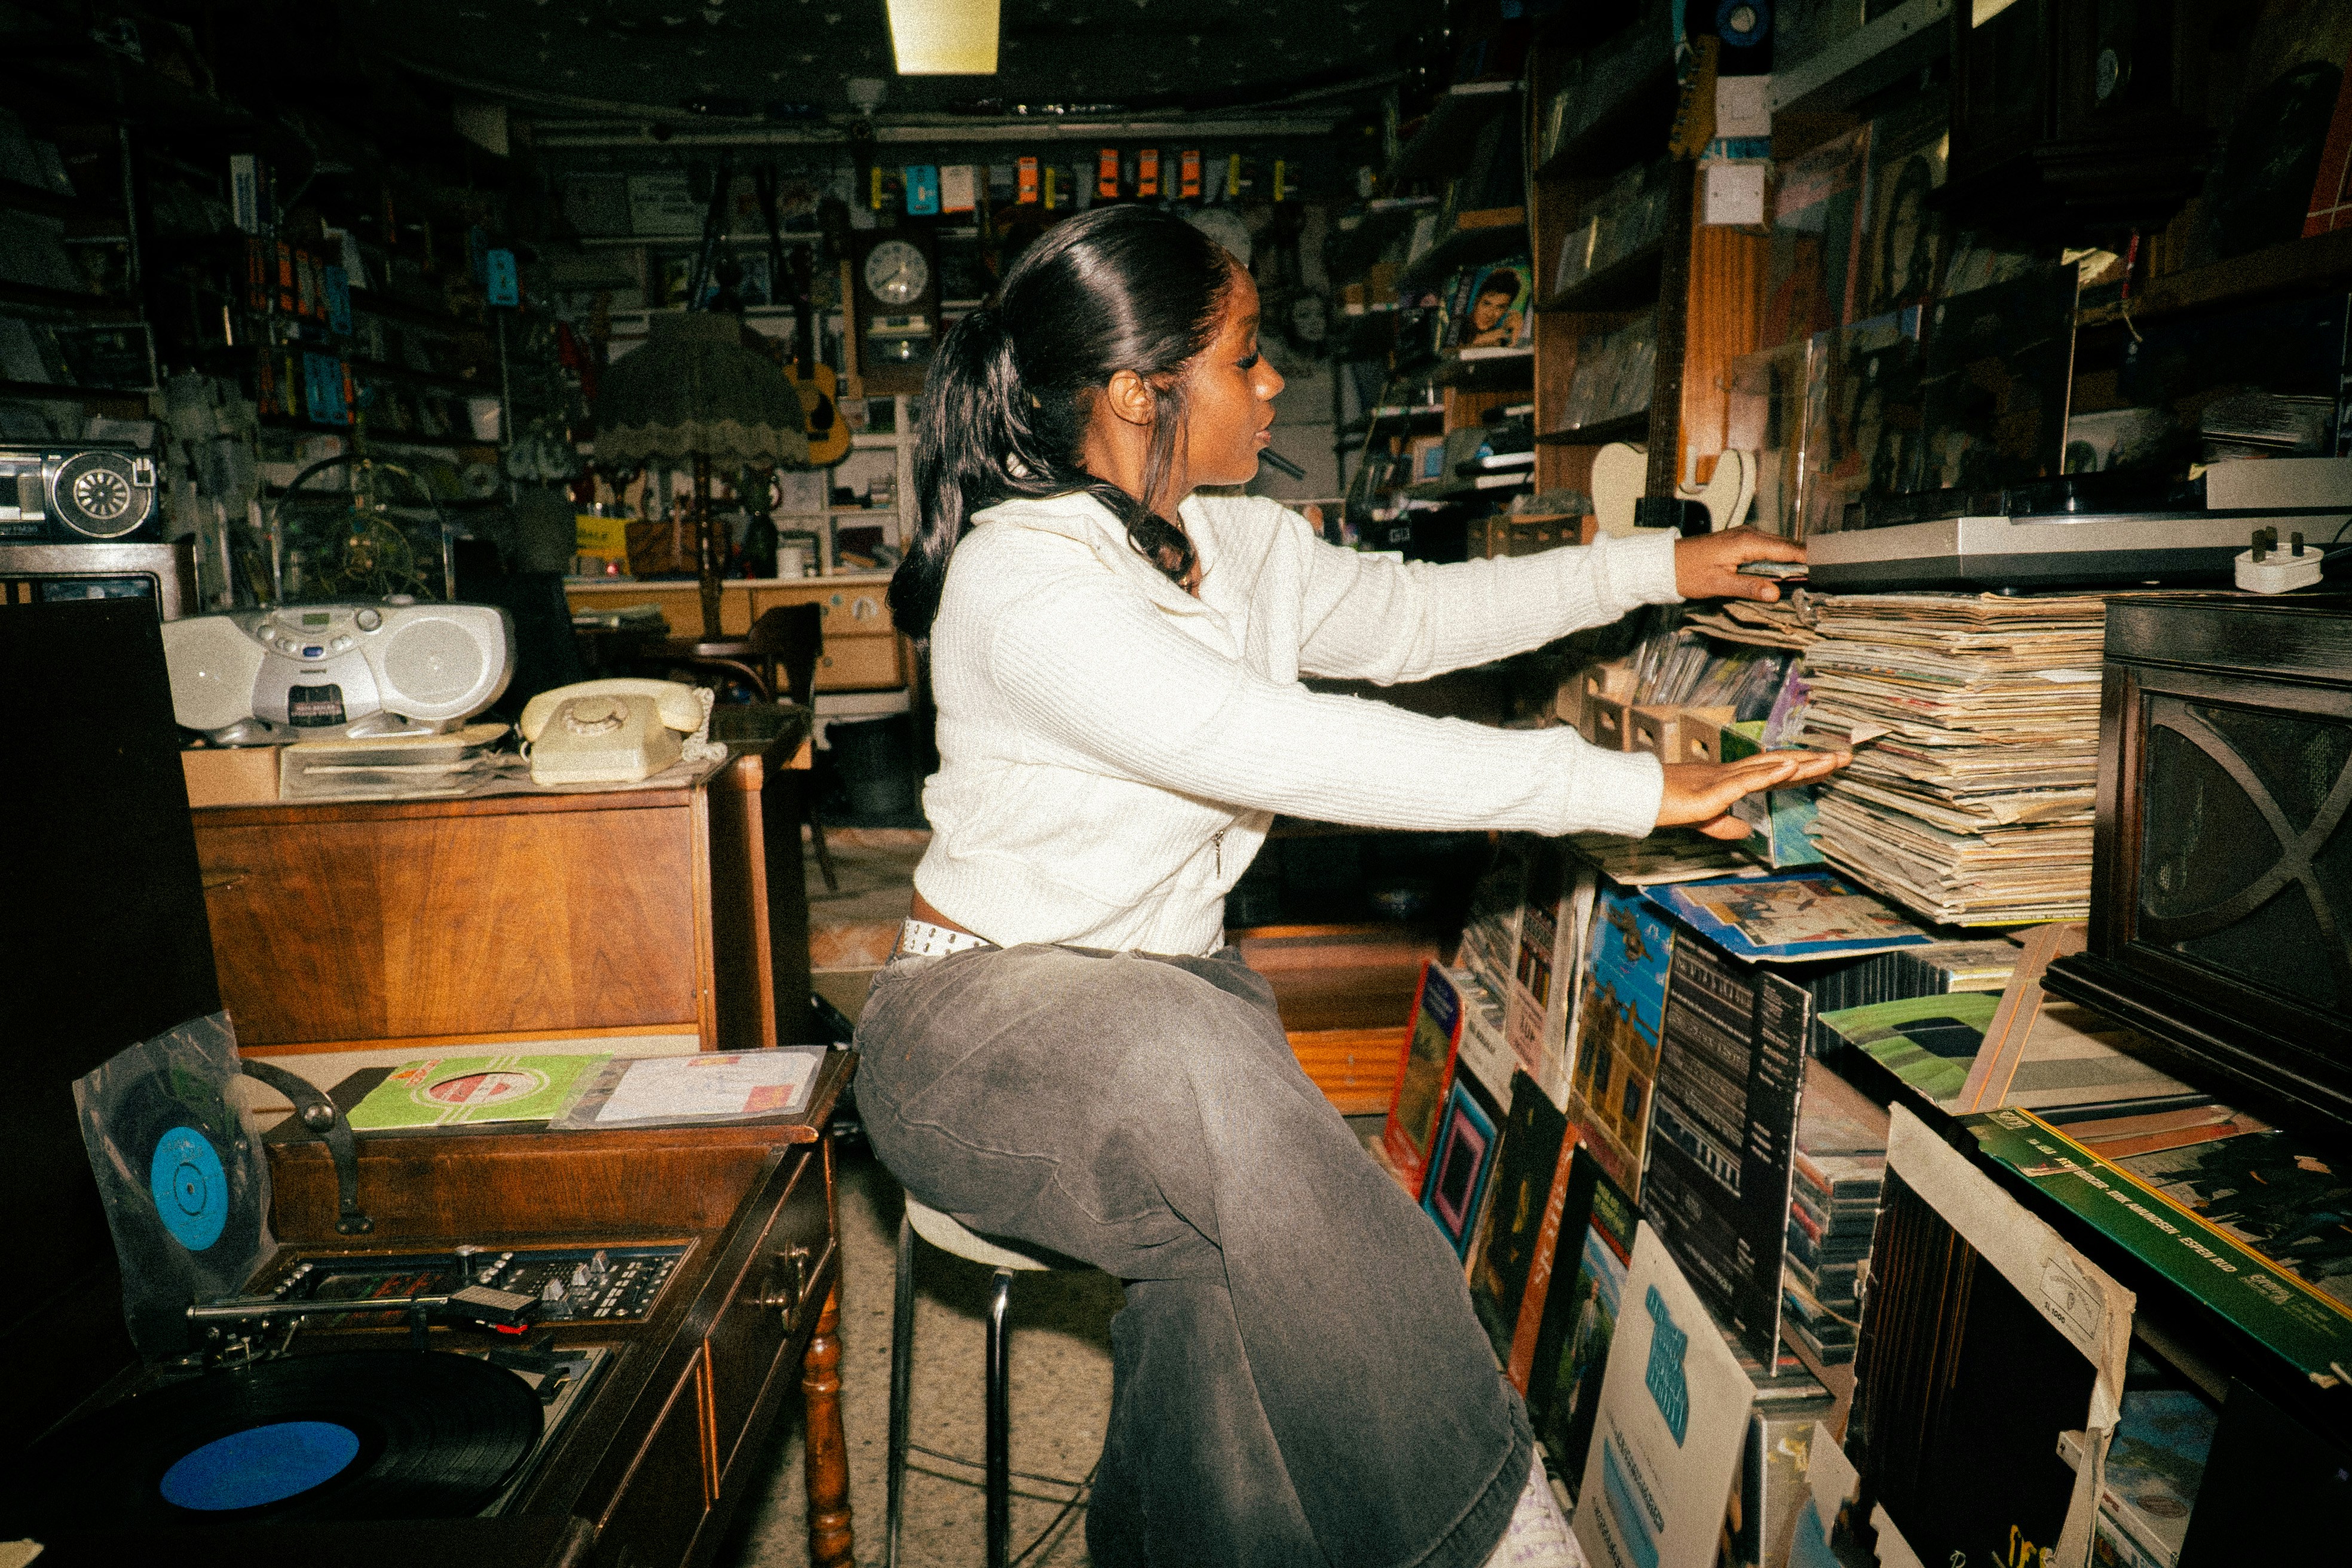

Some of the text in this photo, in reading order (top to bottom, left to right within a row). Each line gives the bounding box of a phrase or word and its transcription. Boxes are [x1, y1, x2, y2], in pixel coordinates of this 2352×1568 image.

[2106, 1190, 2133, 1204] ERIK
[2125, 1203, 2180, 1235] AMUNDSEN
[2178, 1236, 2218, 1258] ESPEN
[2209, 1257, 2238, 1272] RUD
[2052, 1309, 2066, 1324] 1000
